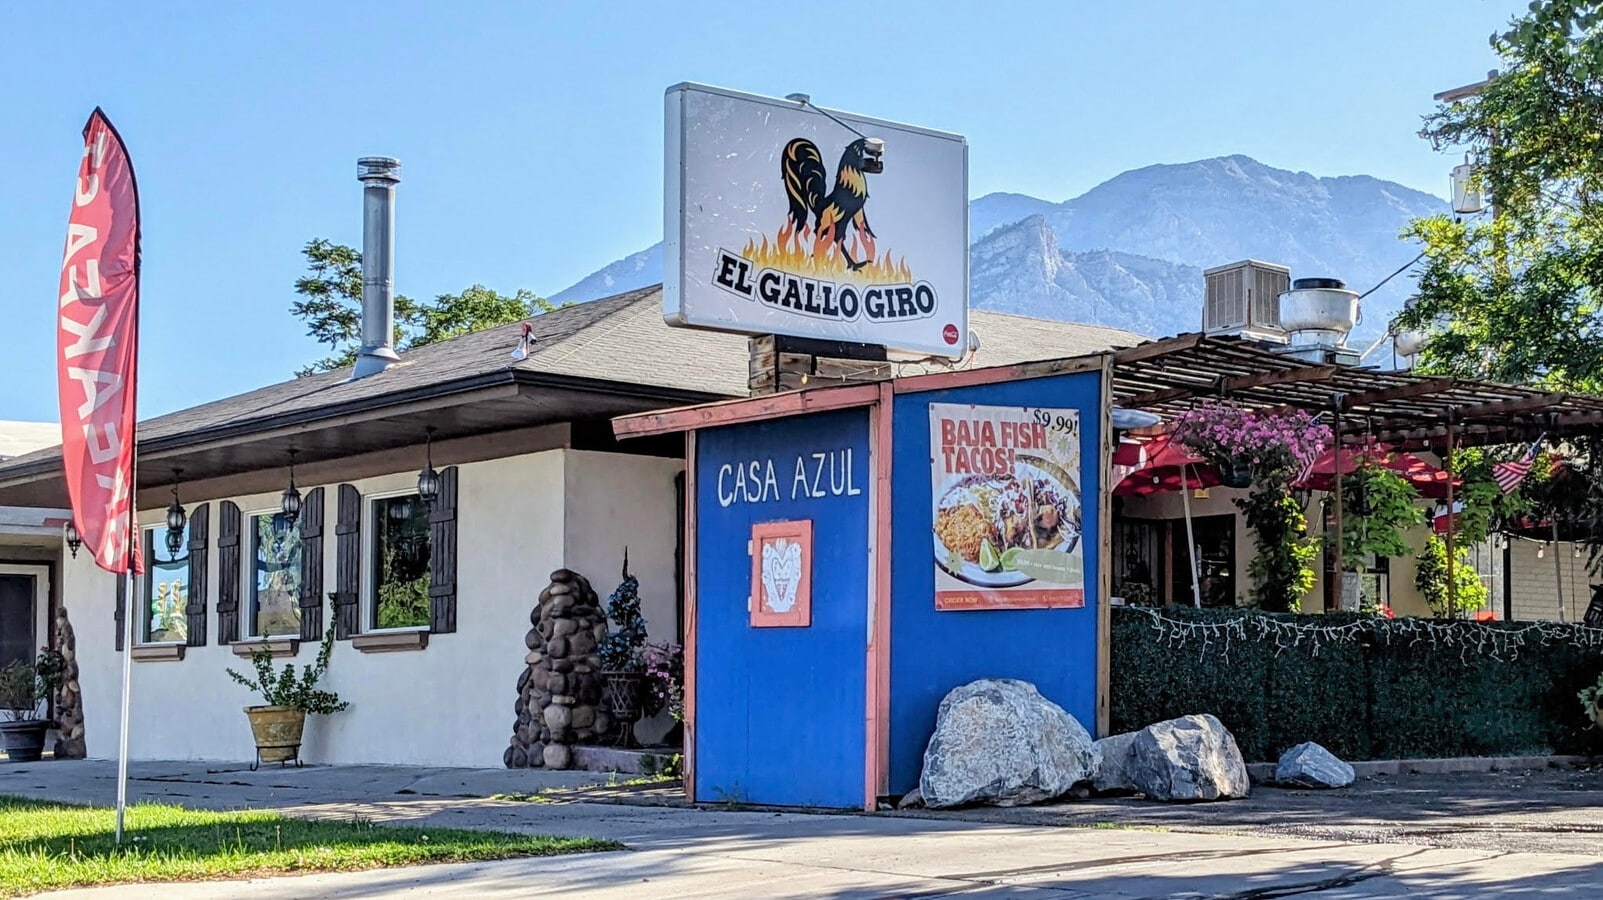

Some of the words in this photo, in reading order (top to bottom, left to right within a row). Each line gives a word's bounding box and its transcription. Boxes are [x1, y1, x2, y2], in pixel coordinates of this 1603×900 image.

[717, 254, 753, 296] EL
[759, 272, 859, 319] GALLO
[865, 283, 935, 319] GIRO
[941, 418, 997, 448] BAJA
[1000, 421, 1047, 449] FISH
[1033, 408, 1079, 437] $9.99!
[942, 446, 1016, 475] TACOS!
[717, 459, 781, 508] CASA
[791, 447, 862, 501] AZUL
